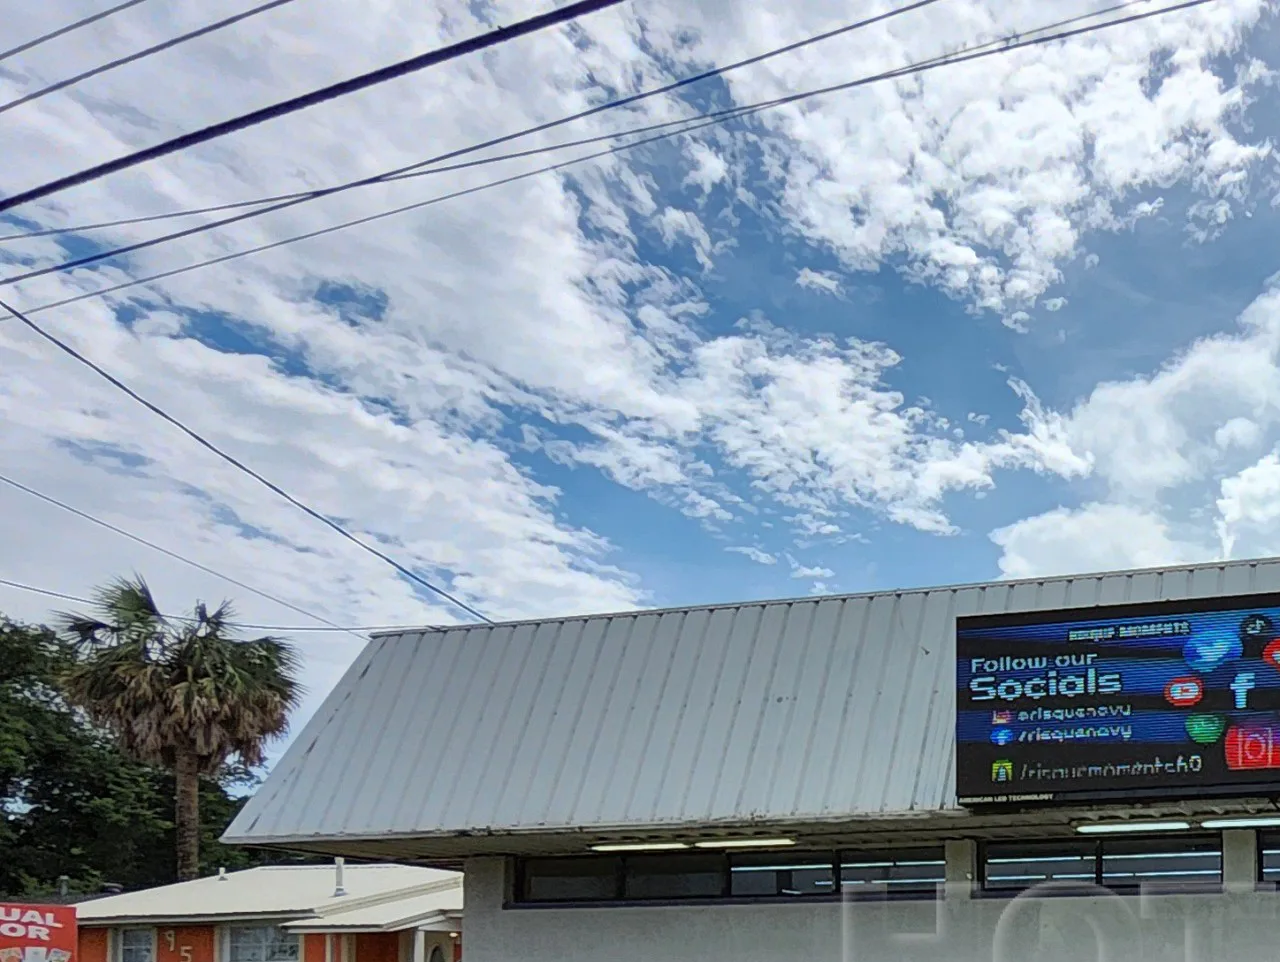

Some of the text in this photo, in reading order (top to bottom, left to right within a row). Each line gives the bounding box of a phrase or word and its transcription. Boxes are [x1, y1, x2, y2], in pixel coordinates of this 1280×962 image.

[971, 653, 1098, 673] Follow our
[969, 668, 1122, 701] Socials
[0, 923, 50, 941] OR
